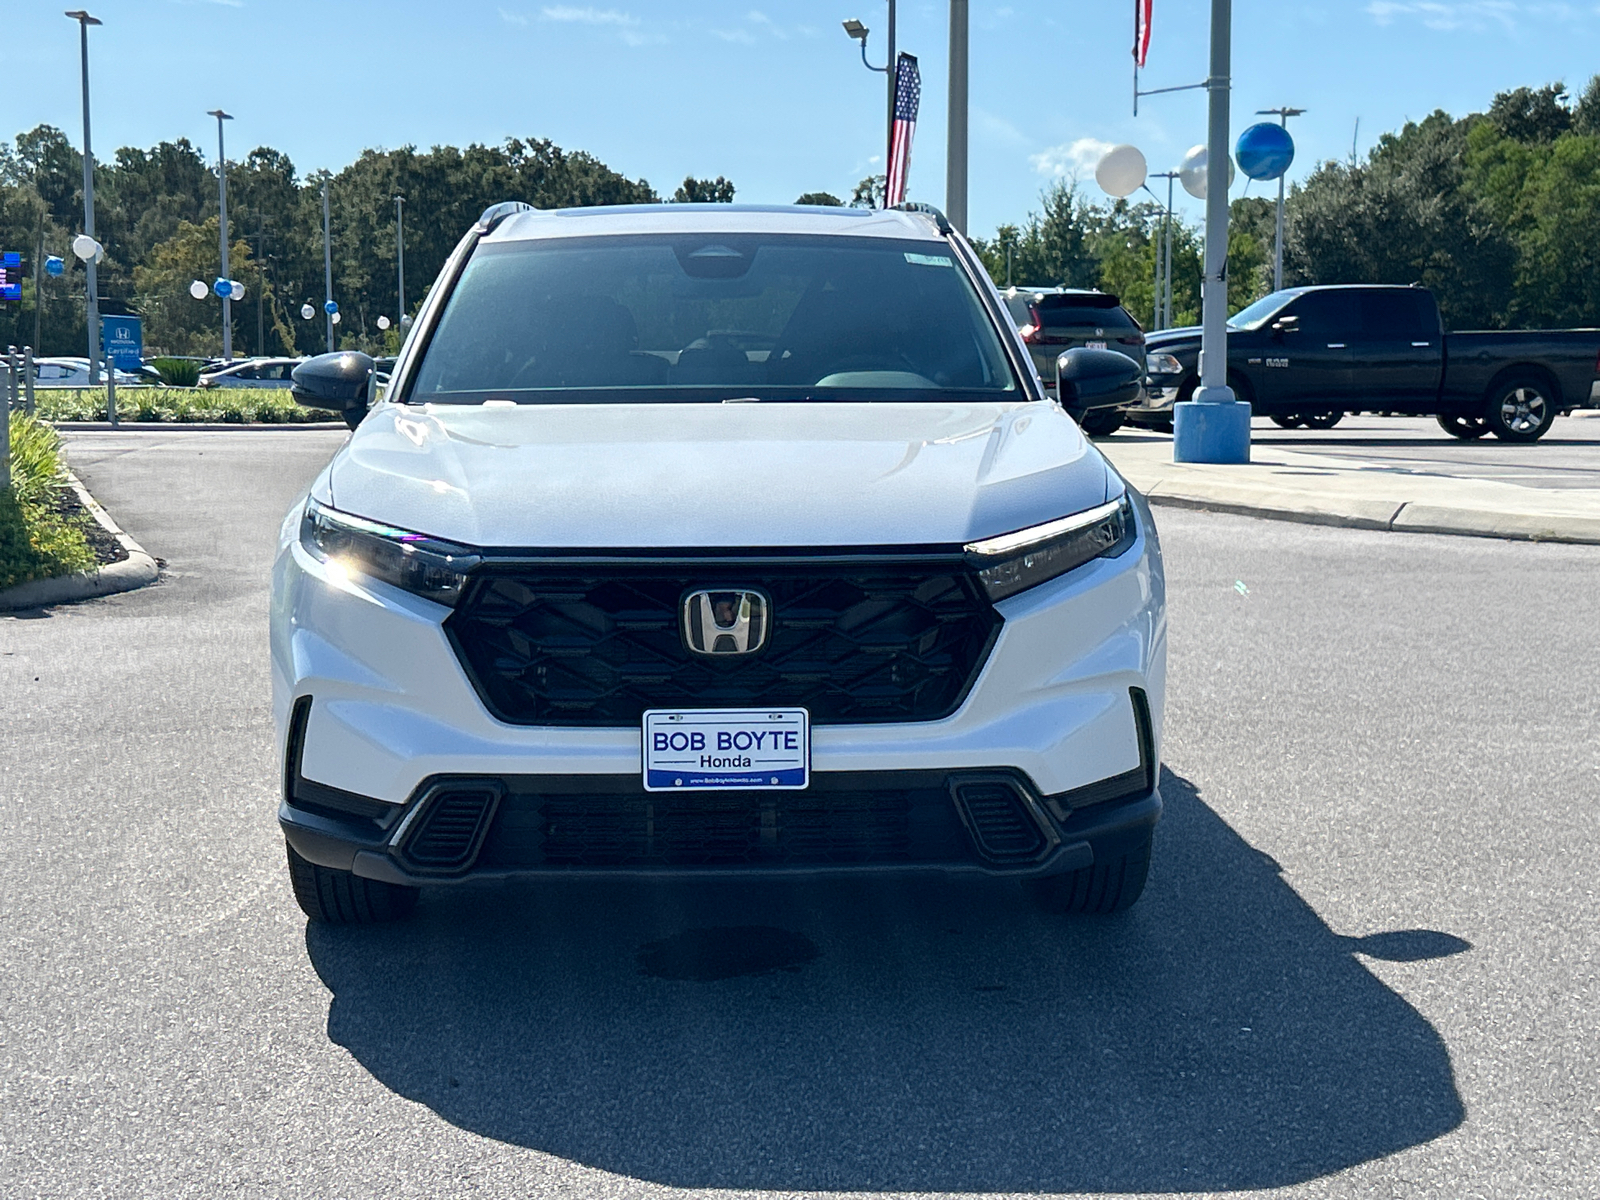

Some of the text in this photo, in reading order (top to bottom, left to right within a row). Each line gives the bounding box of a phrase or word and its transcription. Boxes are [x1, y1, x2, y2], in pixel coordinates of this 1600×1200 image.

[107, 347, 140, 355] Certified
[653, 731, 799, 751] BOB BOYTE
[700, 754, 752, 768] Honda
